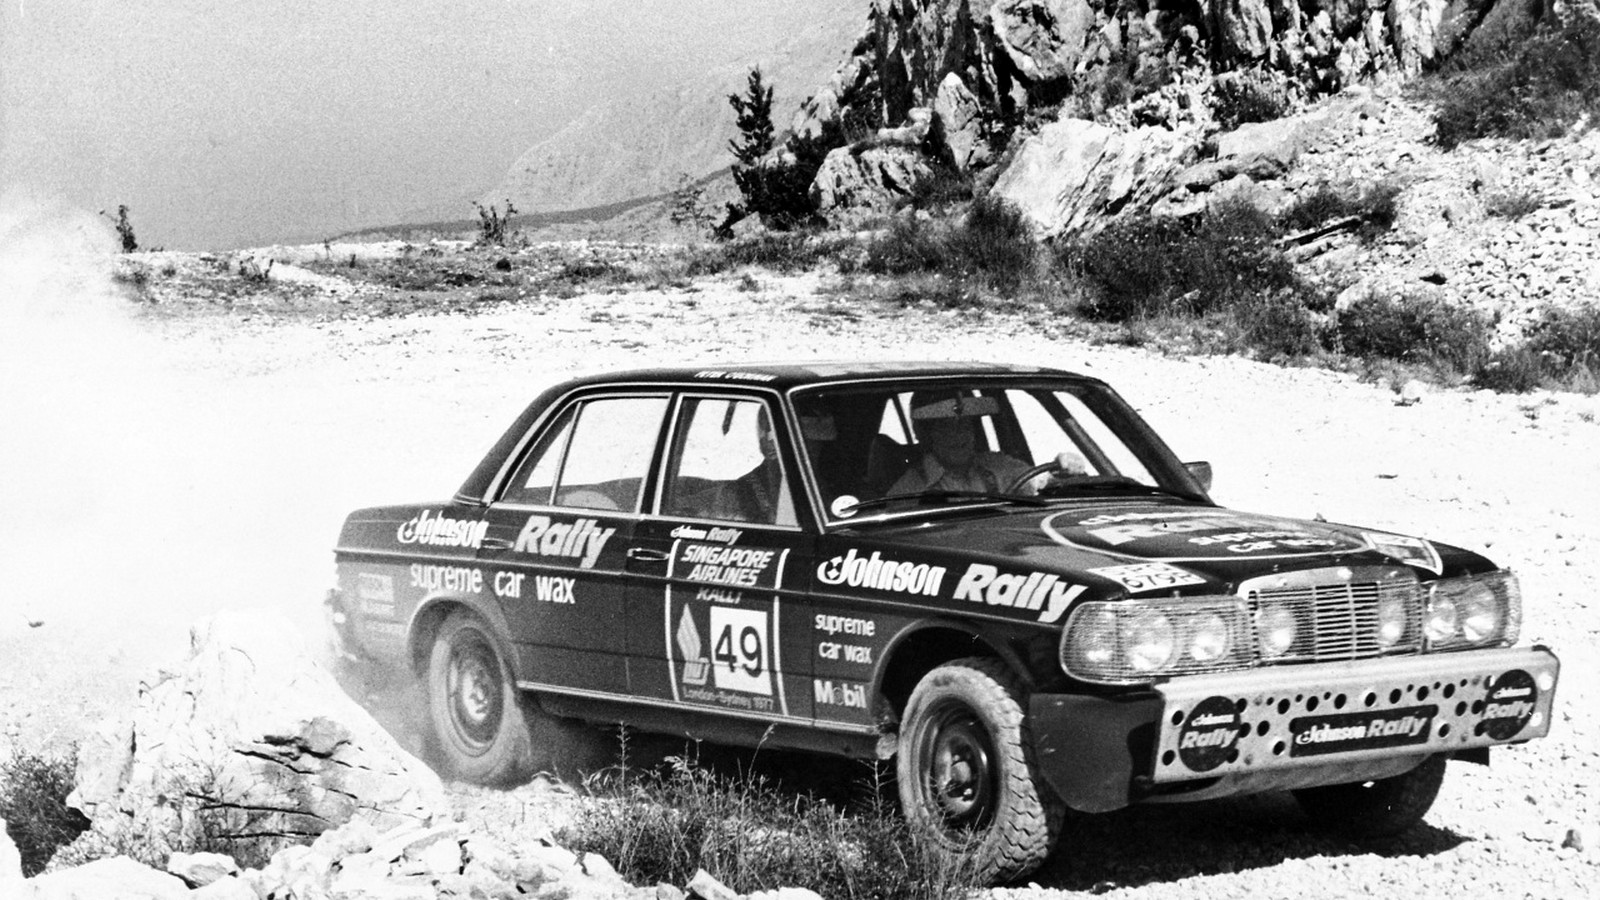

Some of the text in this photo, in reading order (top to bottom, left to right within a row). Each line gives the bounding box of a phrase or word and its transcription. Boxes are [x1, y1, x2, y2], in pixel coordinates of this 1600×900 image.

[397, 509, 617, 569] Johnson Rally
[680, 544, 775, 569] SINGAPORE
[410, 563, 483, 593] supreme
[494, 571, 525, 598] car
[536, 575, 576, 604] wax
[686, 564, 761, 587] AIRLINES
[817, 549, 1089, 624] Johnson Rally
[815, 614, 875, 637] supreme
[715, 623, 762, 678] 49
[819, 641, 872, 664] car wax
[814, 679, 867, 708] Mobil
[1481, 700, 1534, 719] Rally
[1365, 715, 1428, 737] Rally
[1180, 728, 1239, 750] Rally
